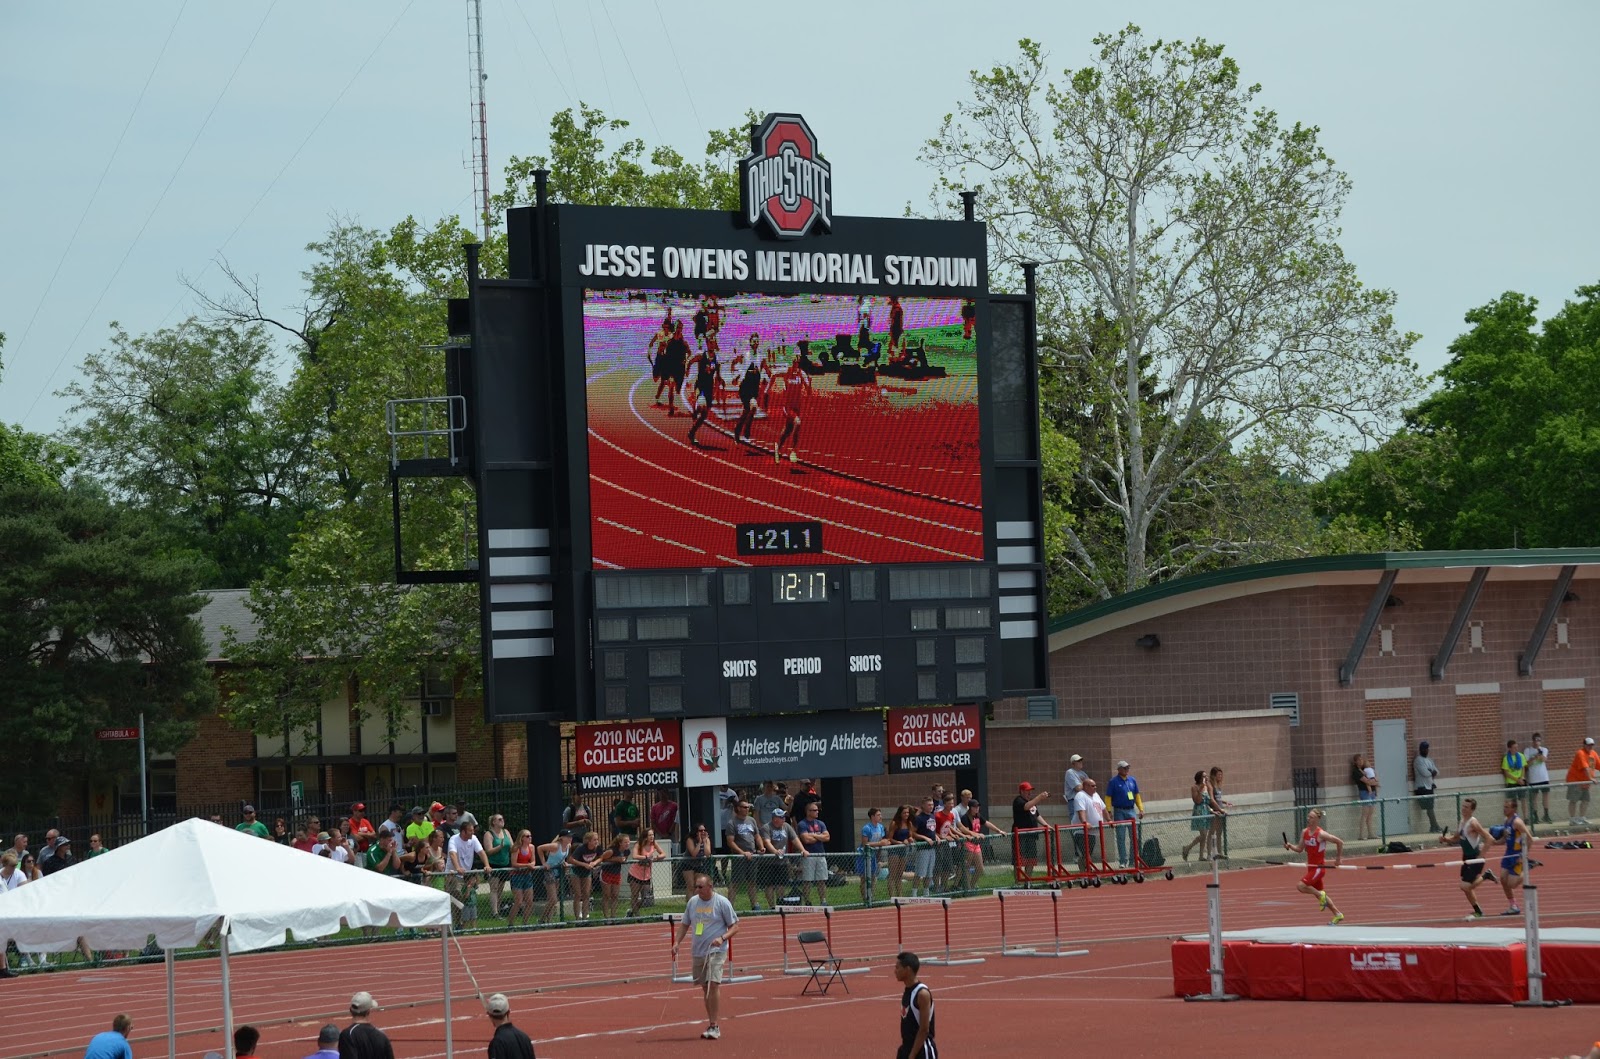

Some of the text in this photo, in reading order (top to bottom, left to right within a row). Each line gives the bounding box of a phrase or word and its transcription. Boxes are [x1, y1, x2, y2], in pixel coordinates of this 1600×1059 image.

[748, 148, 831, 228] OHIO STATE
[578, 244, 978, 287] JESSE OWENS MEMORIAL STADIUM
[745, 528, 811, 549] 1:21.1
[780, 572, 826, 600] 12:17
[722, 660, 757, 678] SHOTS
[783, 657, 822, 675] PERIOD
[849, 654, 882, 672] SHOTS
[902, 711, 967, 730] 2007 NCAA
[593, 727, 664, 747] 2010 NCAA
[732, 732, 878, 757] Athletes Helping Athletes
[894, 728, 976, 747] COLLEGE CUP
[583, 744, 675, 766] COLLEGE CUP
[743, 755, 798, 765] ohiostatebuckeyes.com
[901, 753, 971, 770] MEN'S SOCCER
[581, 770, 678, 789] WOMEN'S SOCCER
[1350, 952, 1402, 966] UCS
